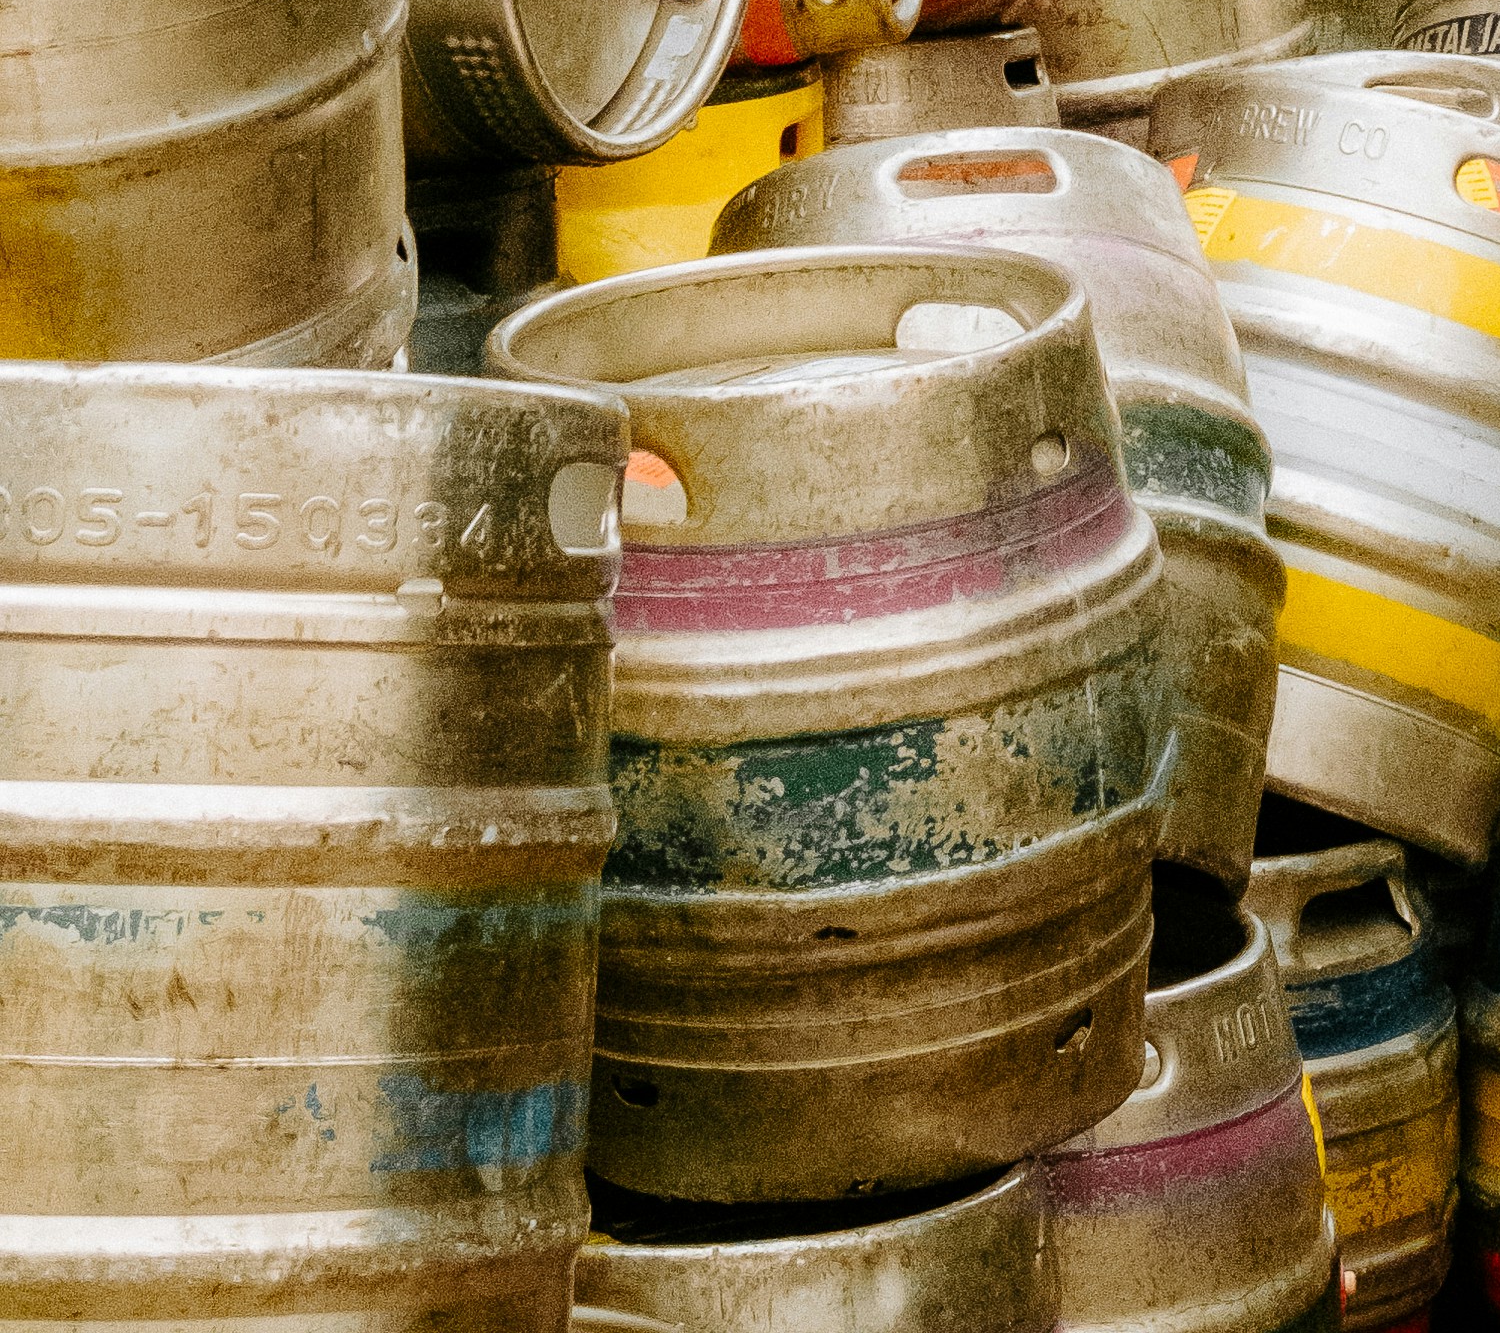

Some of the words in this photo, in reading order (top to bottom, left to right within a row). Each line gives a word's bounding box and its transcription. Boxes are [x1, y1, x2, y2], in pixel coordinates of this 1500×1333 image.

[1237, 101, 1323, 146] BREW
[1337, 120, 1391, 161] CO
[0, 485, 495, 555] 05-150334
